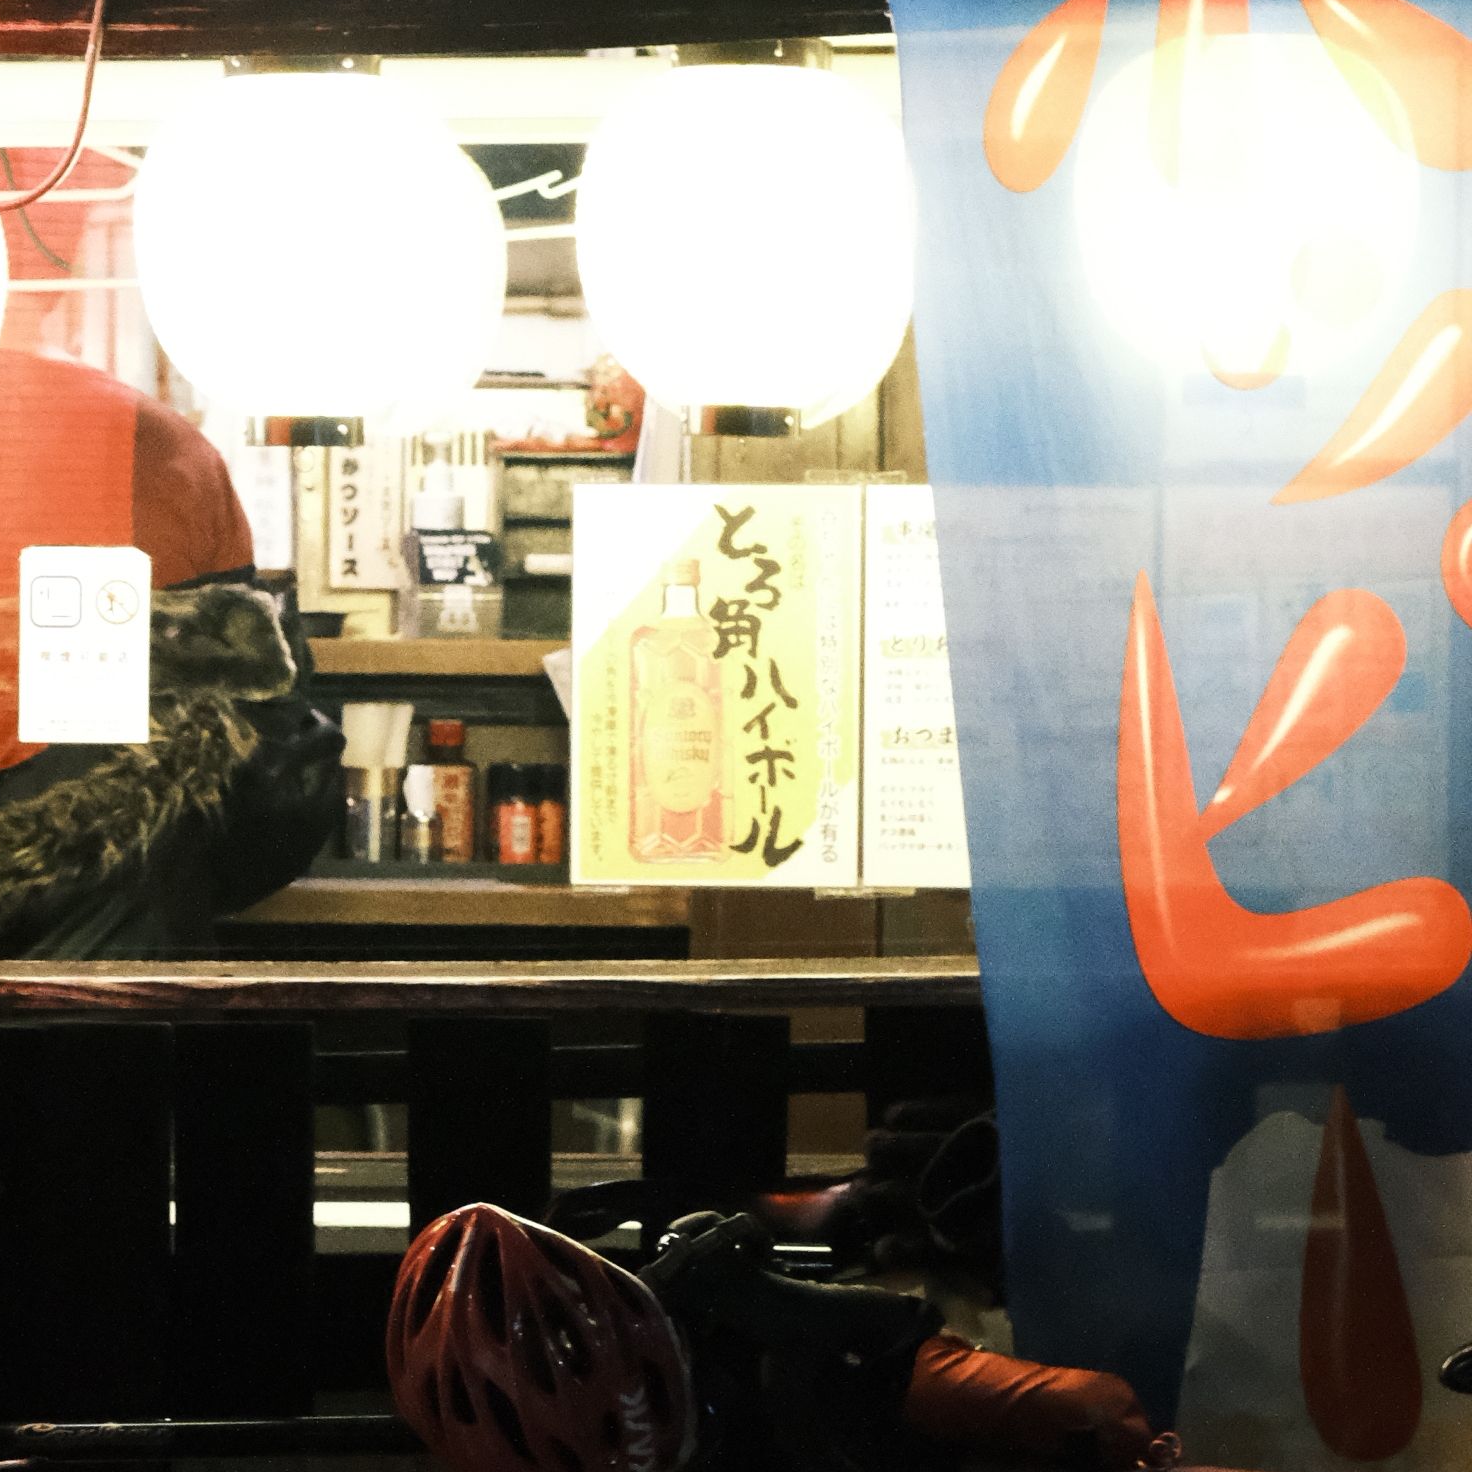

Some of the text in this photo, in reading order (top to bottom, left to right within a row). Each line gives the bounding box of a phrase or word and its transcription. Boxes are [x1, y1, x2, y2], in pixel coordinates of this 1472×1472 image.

[709, 503, 803, 868] とろ角ハイボール
